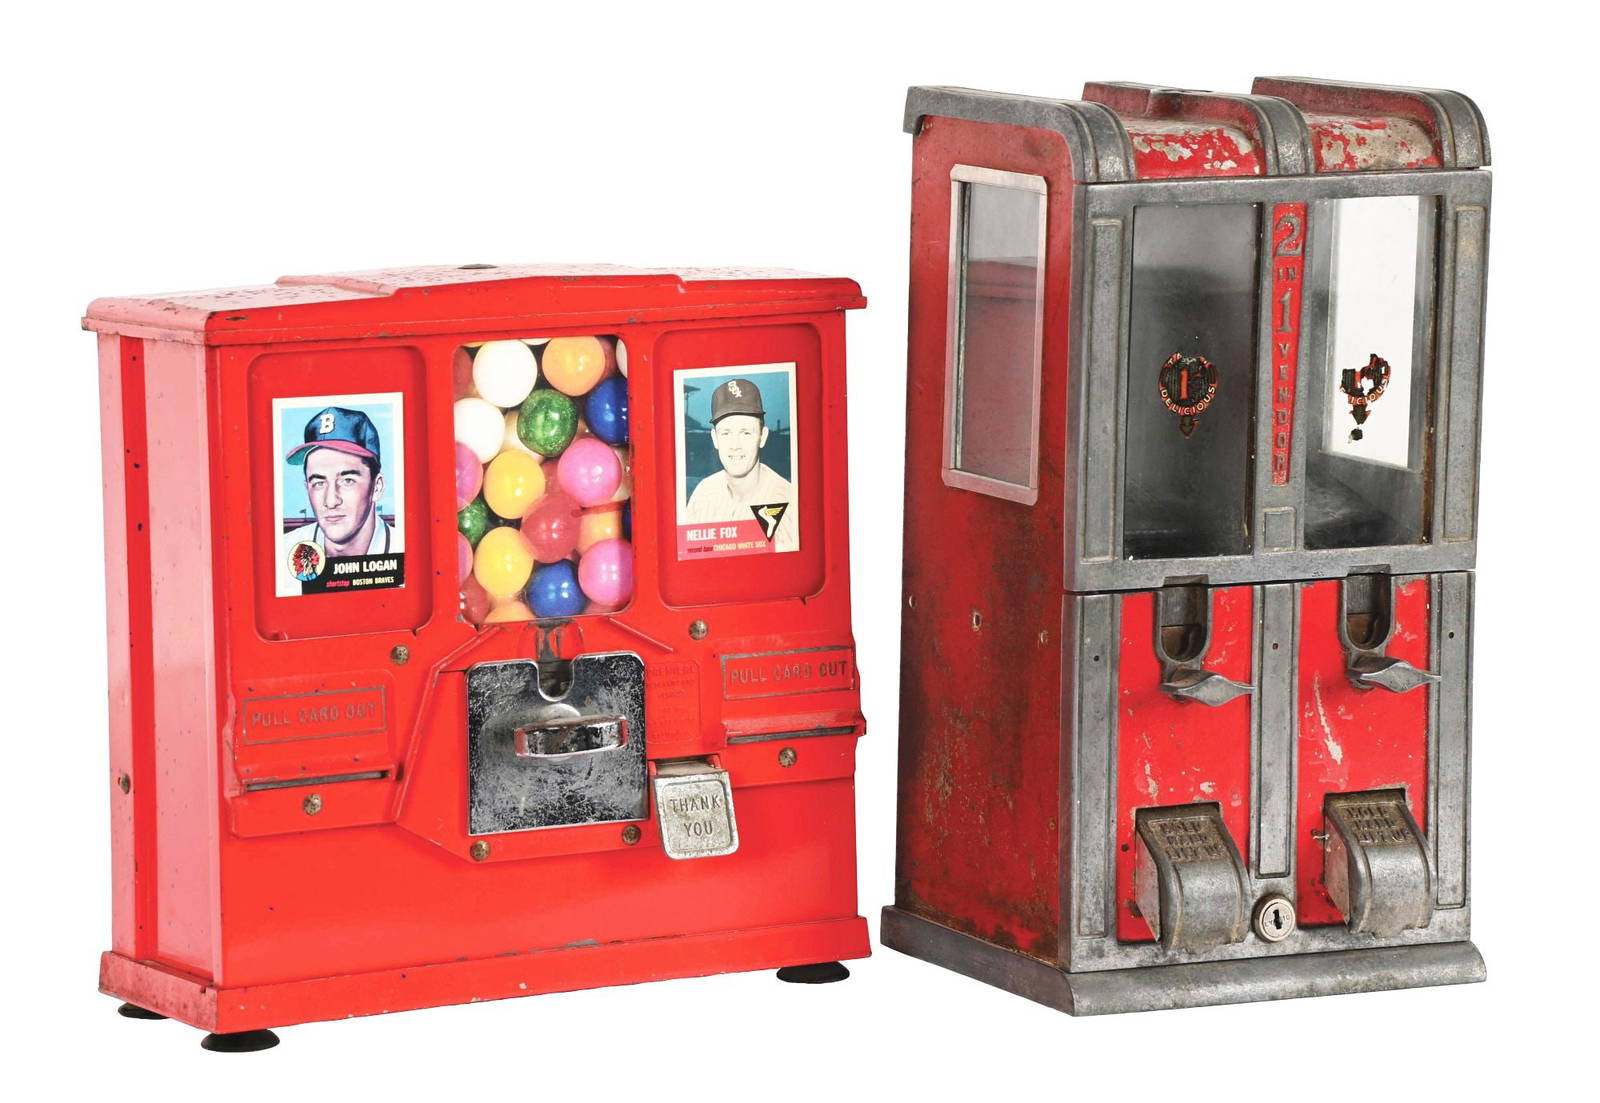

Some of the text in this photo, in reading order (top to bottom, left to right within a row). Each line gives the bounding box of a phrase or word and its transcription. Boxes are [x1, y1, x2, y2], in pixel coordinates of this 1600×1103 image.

[1276, 216, 1302, 474] 2 IN 1 VENDOR
[1160, 387, 1217, 415] DELICIOUS
[319, 413, 336, 434] B
[686, 526, 738, 541] NELLIE FOX
[333, 559, 398, 575] JOHN LOGAN
[352, 578, 373, 586] BOSTON
[374, 576, 394, 585] BRAVES
[730, 661, 848, 684] PULL CARD OUT
[251, 702, 377, 728] PULL CARD OUT
[669, 794, 721, 837] THANK YOU
